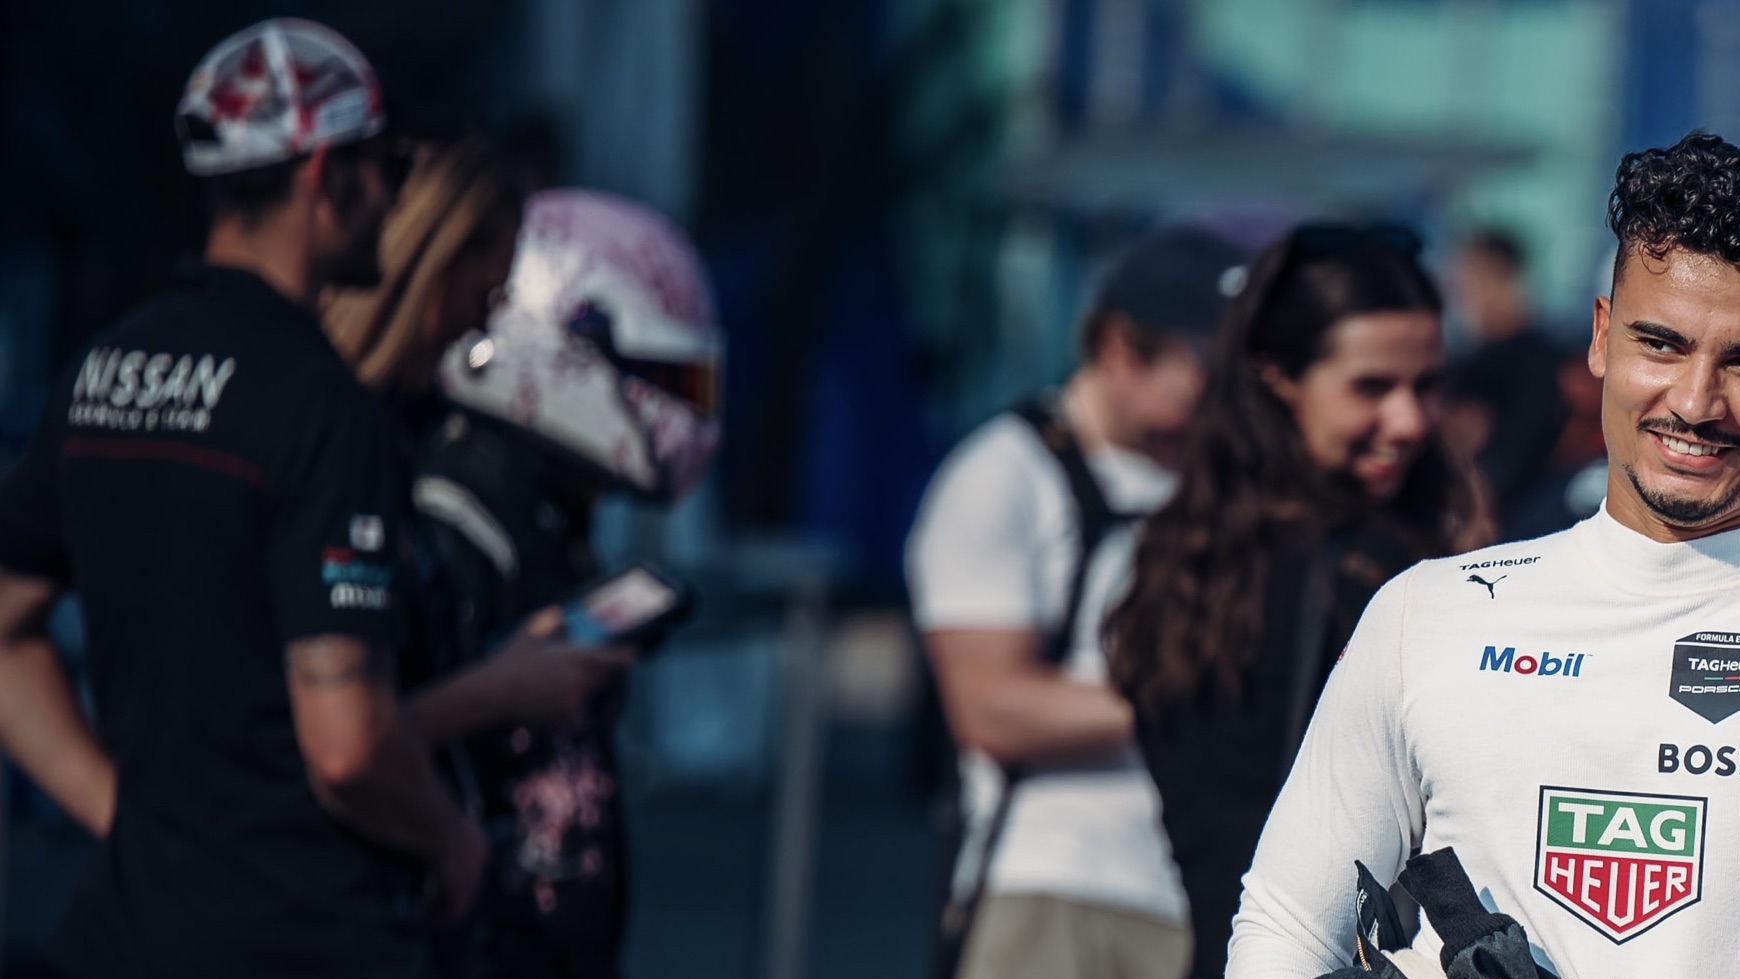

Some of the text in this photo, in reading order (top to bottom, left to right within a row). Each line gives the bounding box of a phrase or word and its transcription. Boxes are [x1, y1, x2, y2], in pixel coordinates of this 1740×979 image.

[1696, 633, 1734, 643] FORMULA
[1735, 635, 1740, 643] E
[1479, 645, 1585, 677] Mobil
[1558, 801, 1686, 850] TAG
[1550, 856, 1688, 928] HEUER
